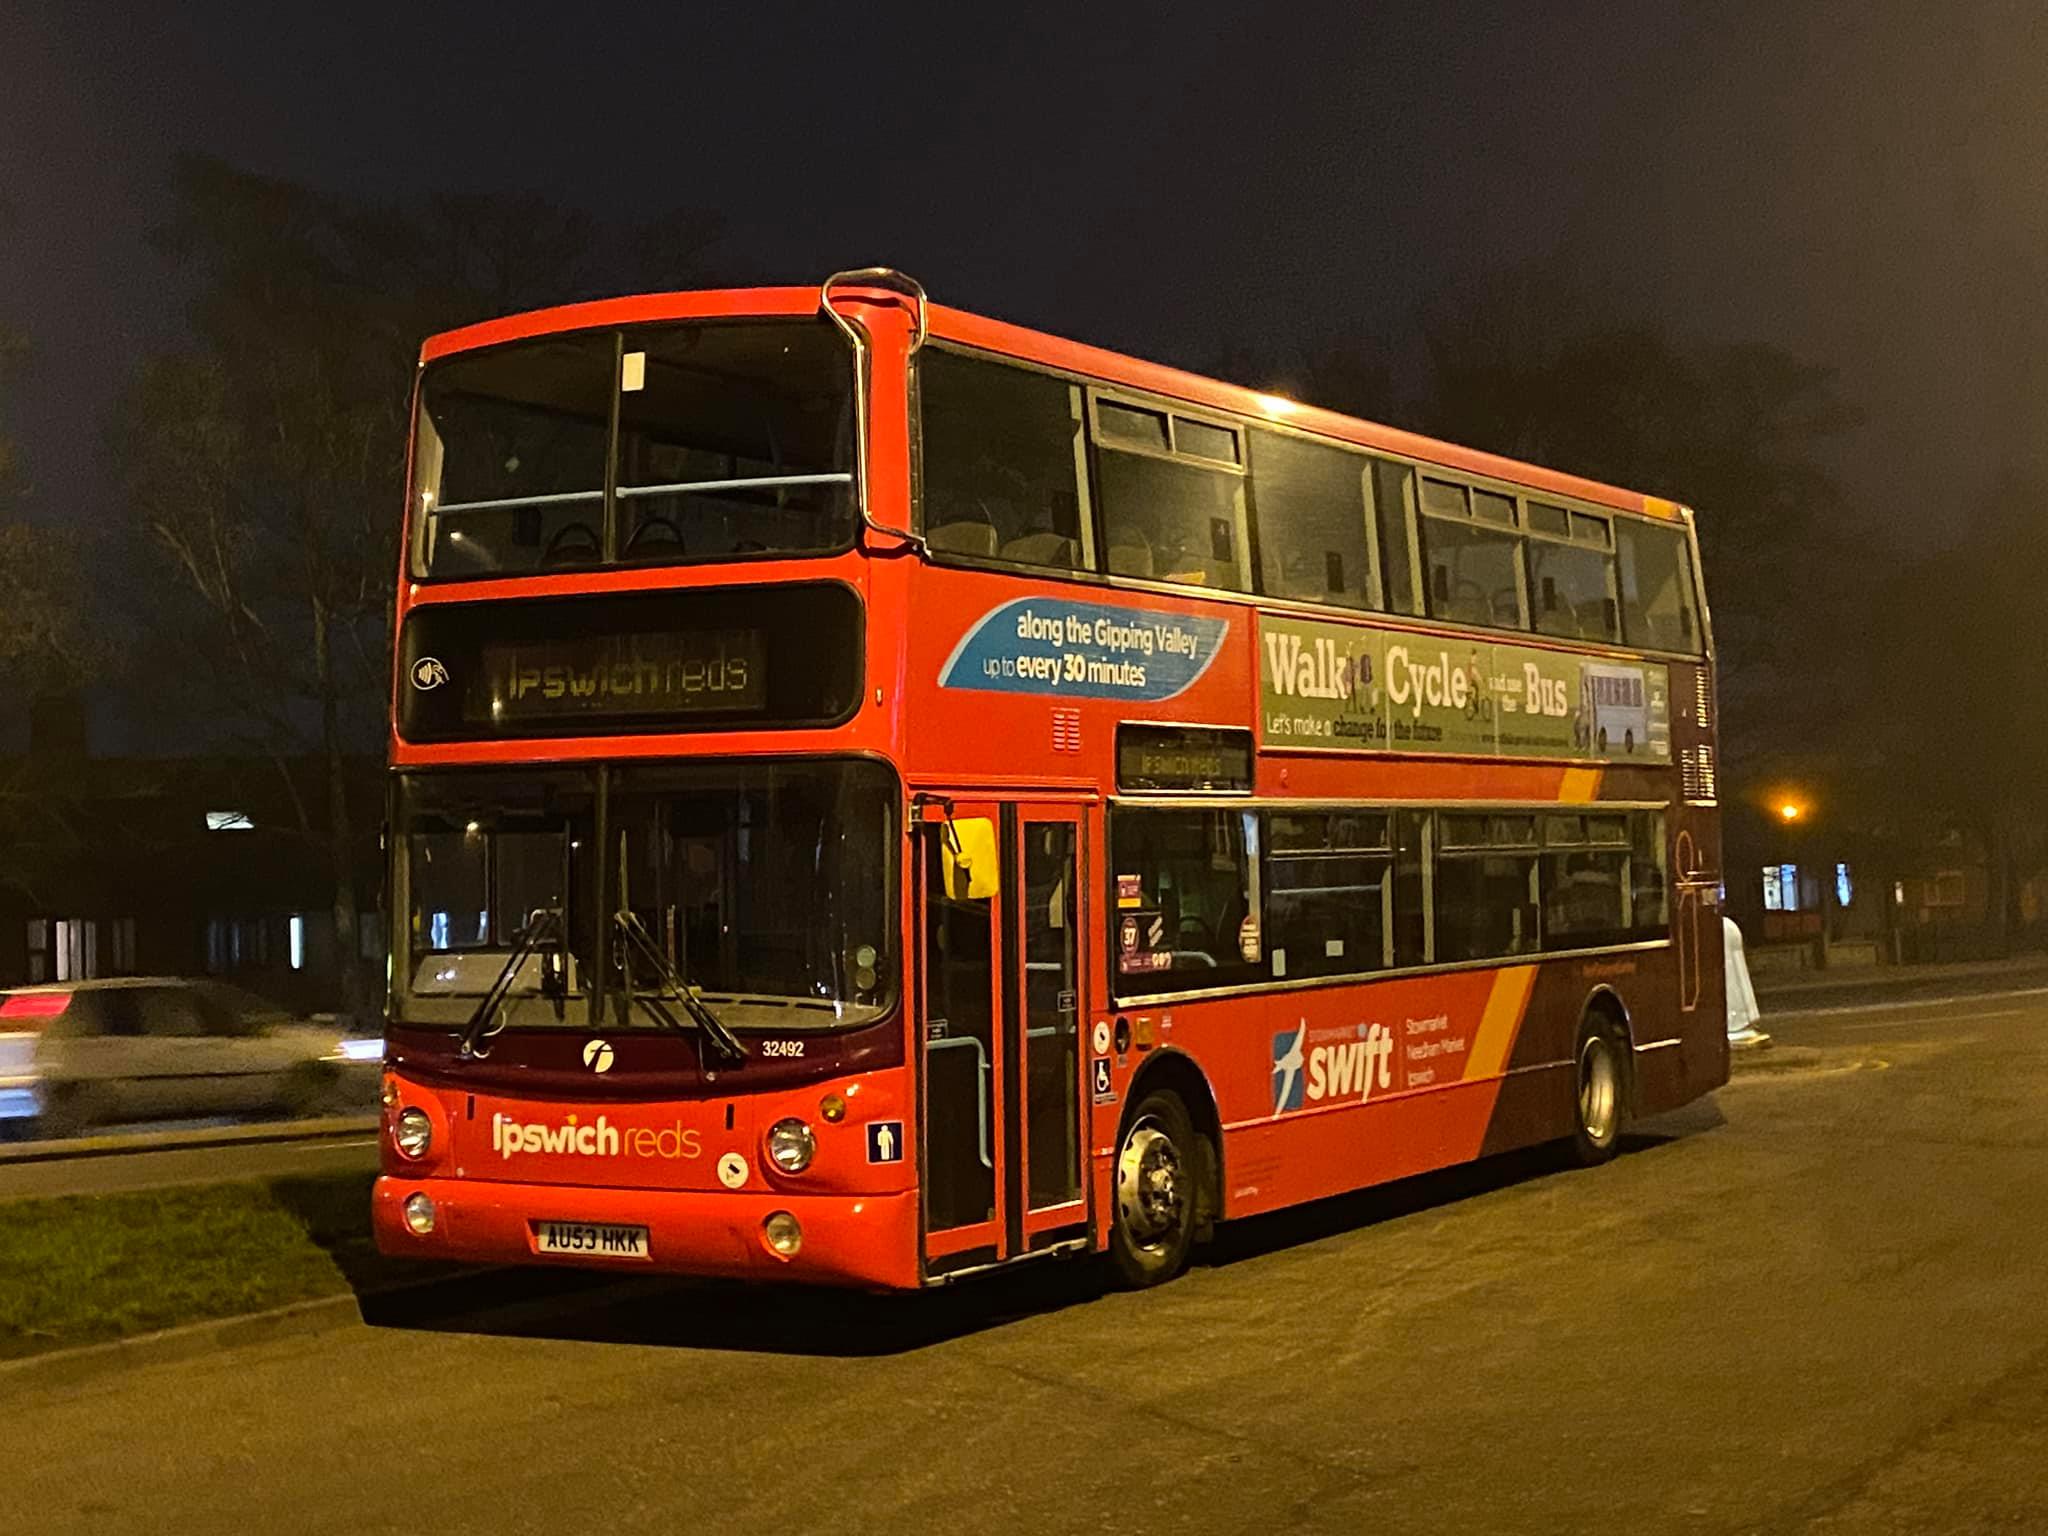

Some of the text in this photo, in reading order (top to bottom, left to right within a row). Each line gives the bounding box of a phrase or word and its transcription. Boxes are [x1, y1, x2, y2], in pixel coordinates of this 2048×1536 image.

[1017, 610, 1199, 660] along the Gipping Valley
[983, 653, 1146, 687] up to every 30 minutes
[1265, 632, 1467, 718] Walk Cycle
[1523, 662, 1568, 717] Bus
[1266, 712, 1290, 735] Let's
[1293, 714, 1322, 736] make
[1333, 715, 1374, 743] change
[762, 1041, 805, 1057] 32492
[1306, 1023, 1393, 1105] swift
[493, 1112, 702, 1160] Ipswich reds
[546, 1225, 640, 1253] AU53 HKK
